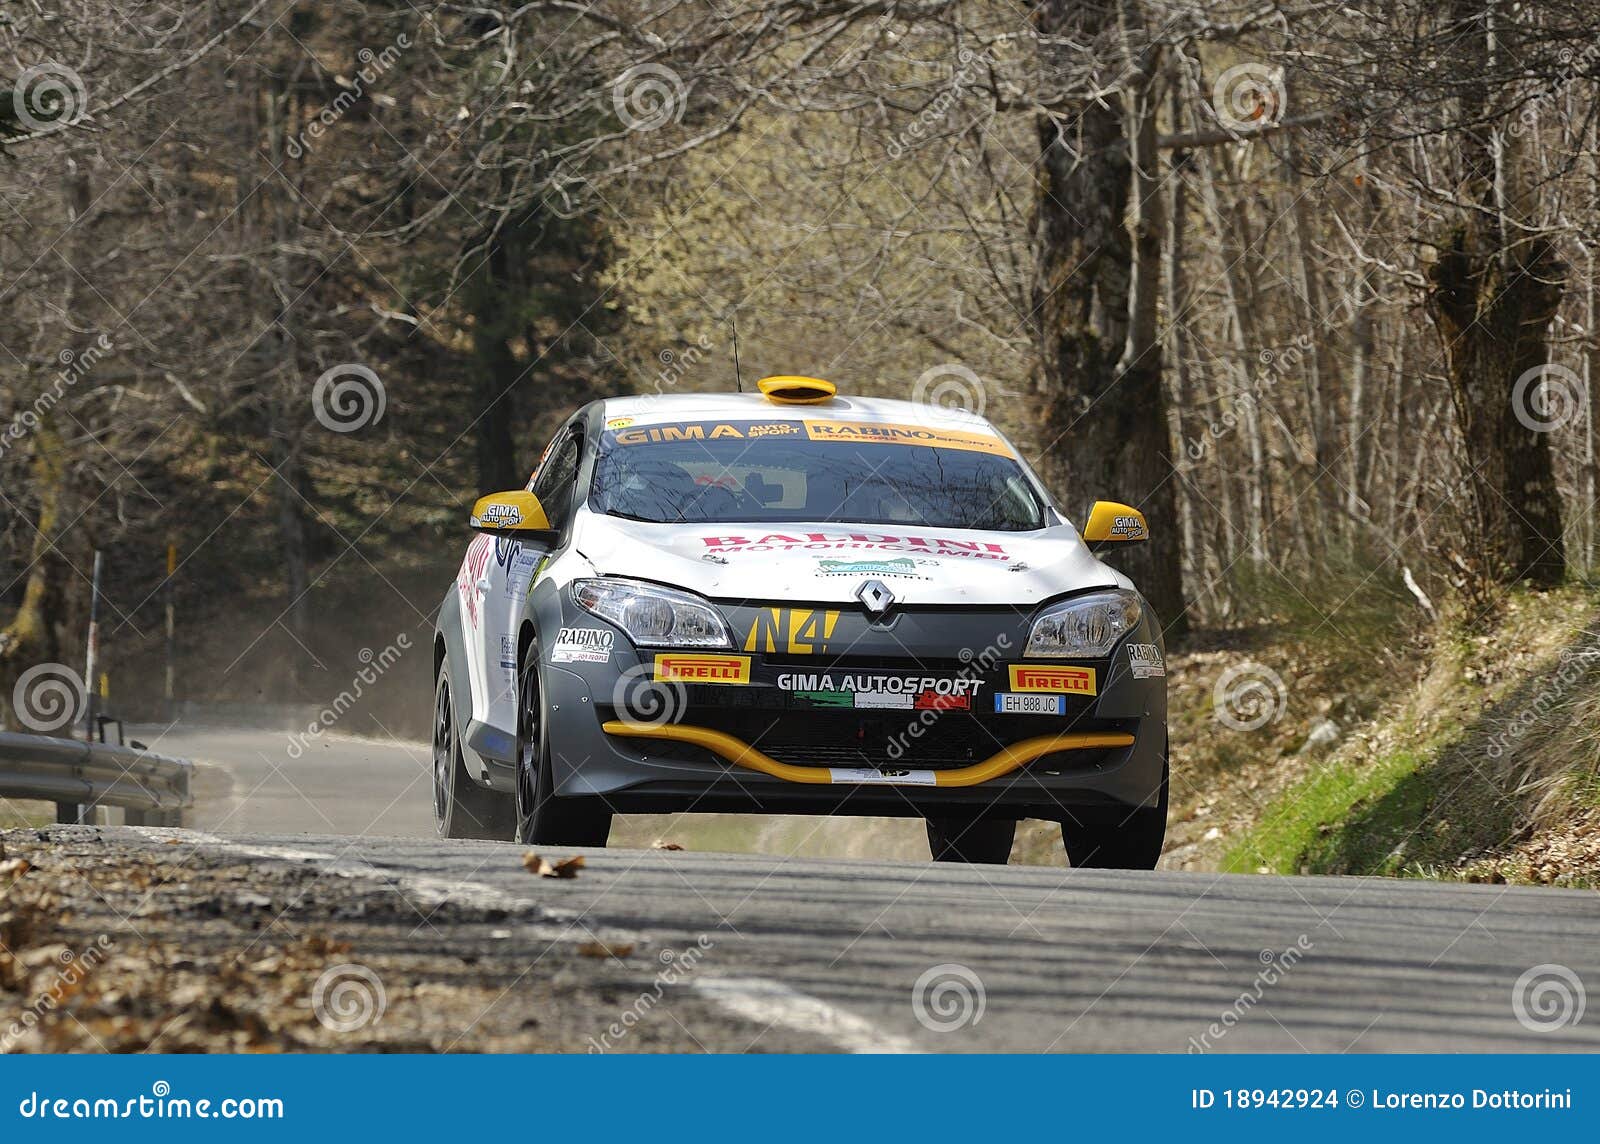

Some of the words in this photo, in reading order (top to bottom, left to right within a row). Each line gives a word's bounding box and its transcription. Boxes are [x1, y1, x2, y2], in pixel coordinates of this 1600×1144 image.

[615, 424, 745, 444] GIMA
[749, 423, 790, 431] AUTO
[748, 427, 800, 437] SPORT
[812, 425, 936, 440] RABINO
[488, 505, 519, 517] GIMA
[1115, 517, 1141, 528] GIMA
[702, 533, 1007, 554] BALDINI
[708, 543, 1010, 561] MOTORICAMBI
[557, 629, 613, 647] RABINO
[662, 659, 741, 679] PIRELLI
[777, 673, 835, 692] GIMA
[839, 675, 985, 697] AUTOSPORT
[1016, 669, 1089, 690] PIRELLI
[1006, 696, 1020, 711] EH
[1023, 697, 1040, 711] 988
[1043, 698, 1055, 712] JC
